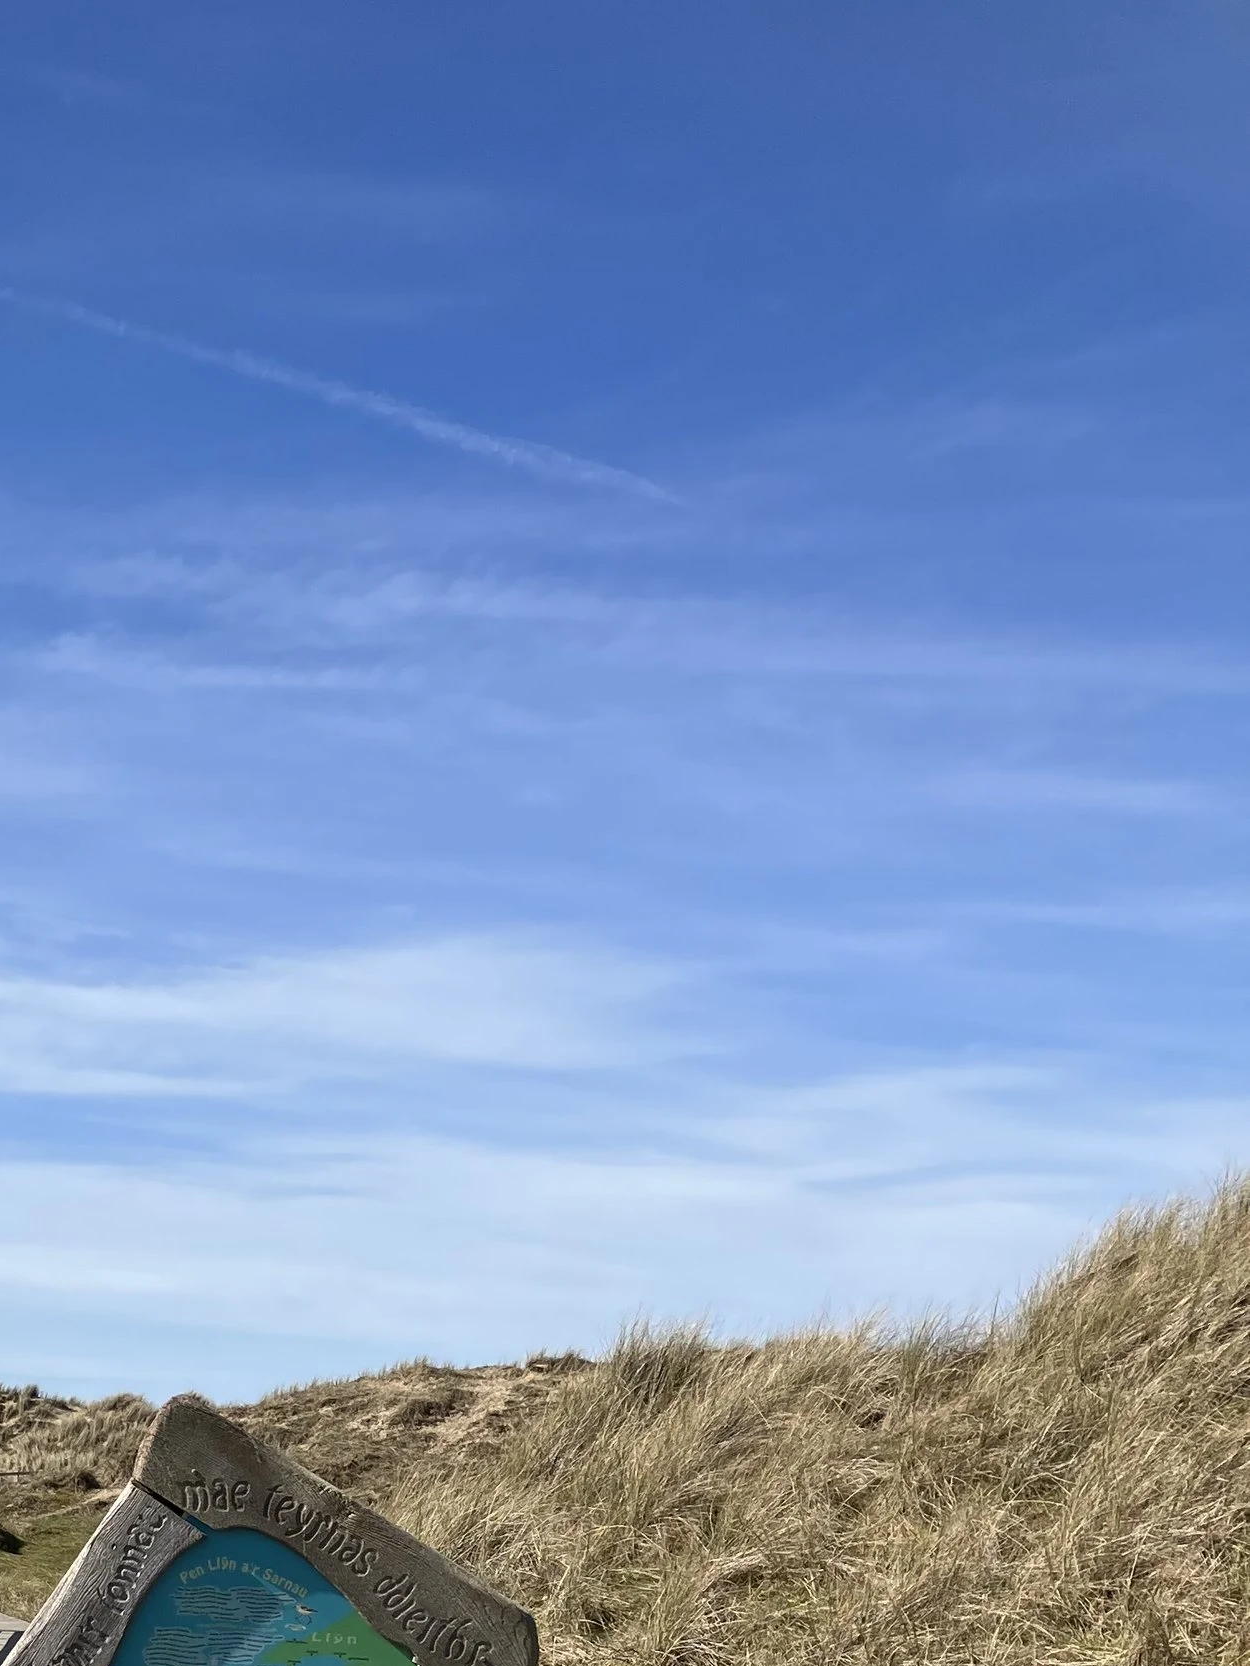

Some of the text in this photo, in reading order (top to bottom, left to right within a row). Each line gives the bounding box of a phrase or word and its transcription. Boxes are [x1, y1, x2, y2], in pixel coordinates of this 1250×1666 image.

[182, 1477, 251, 1513] mae
[179, 1566, 206, 1584] Pen
[262, 1568, 309, 1598] Sarnau
